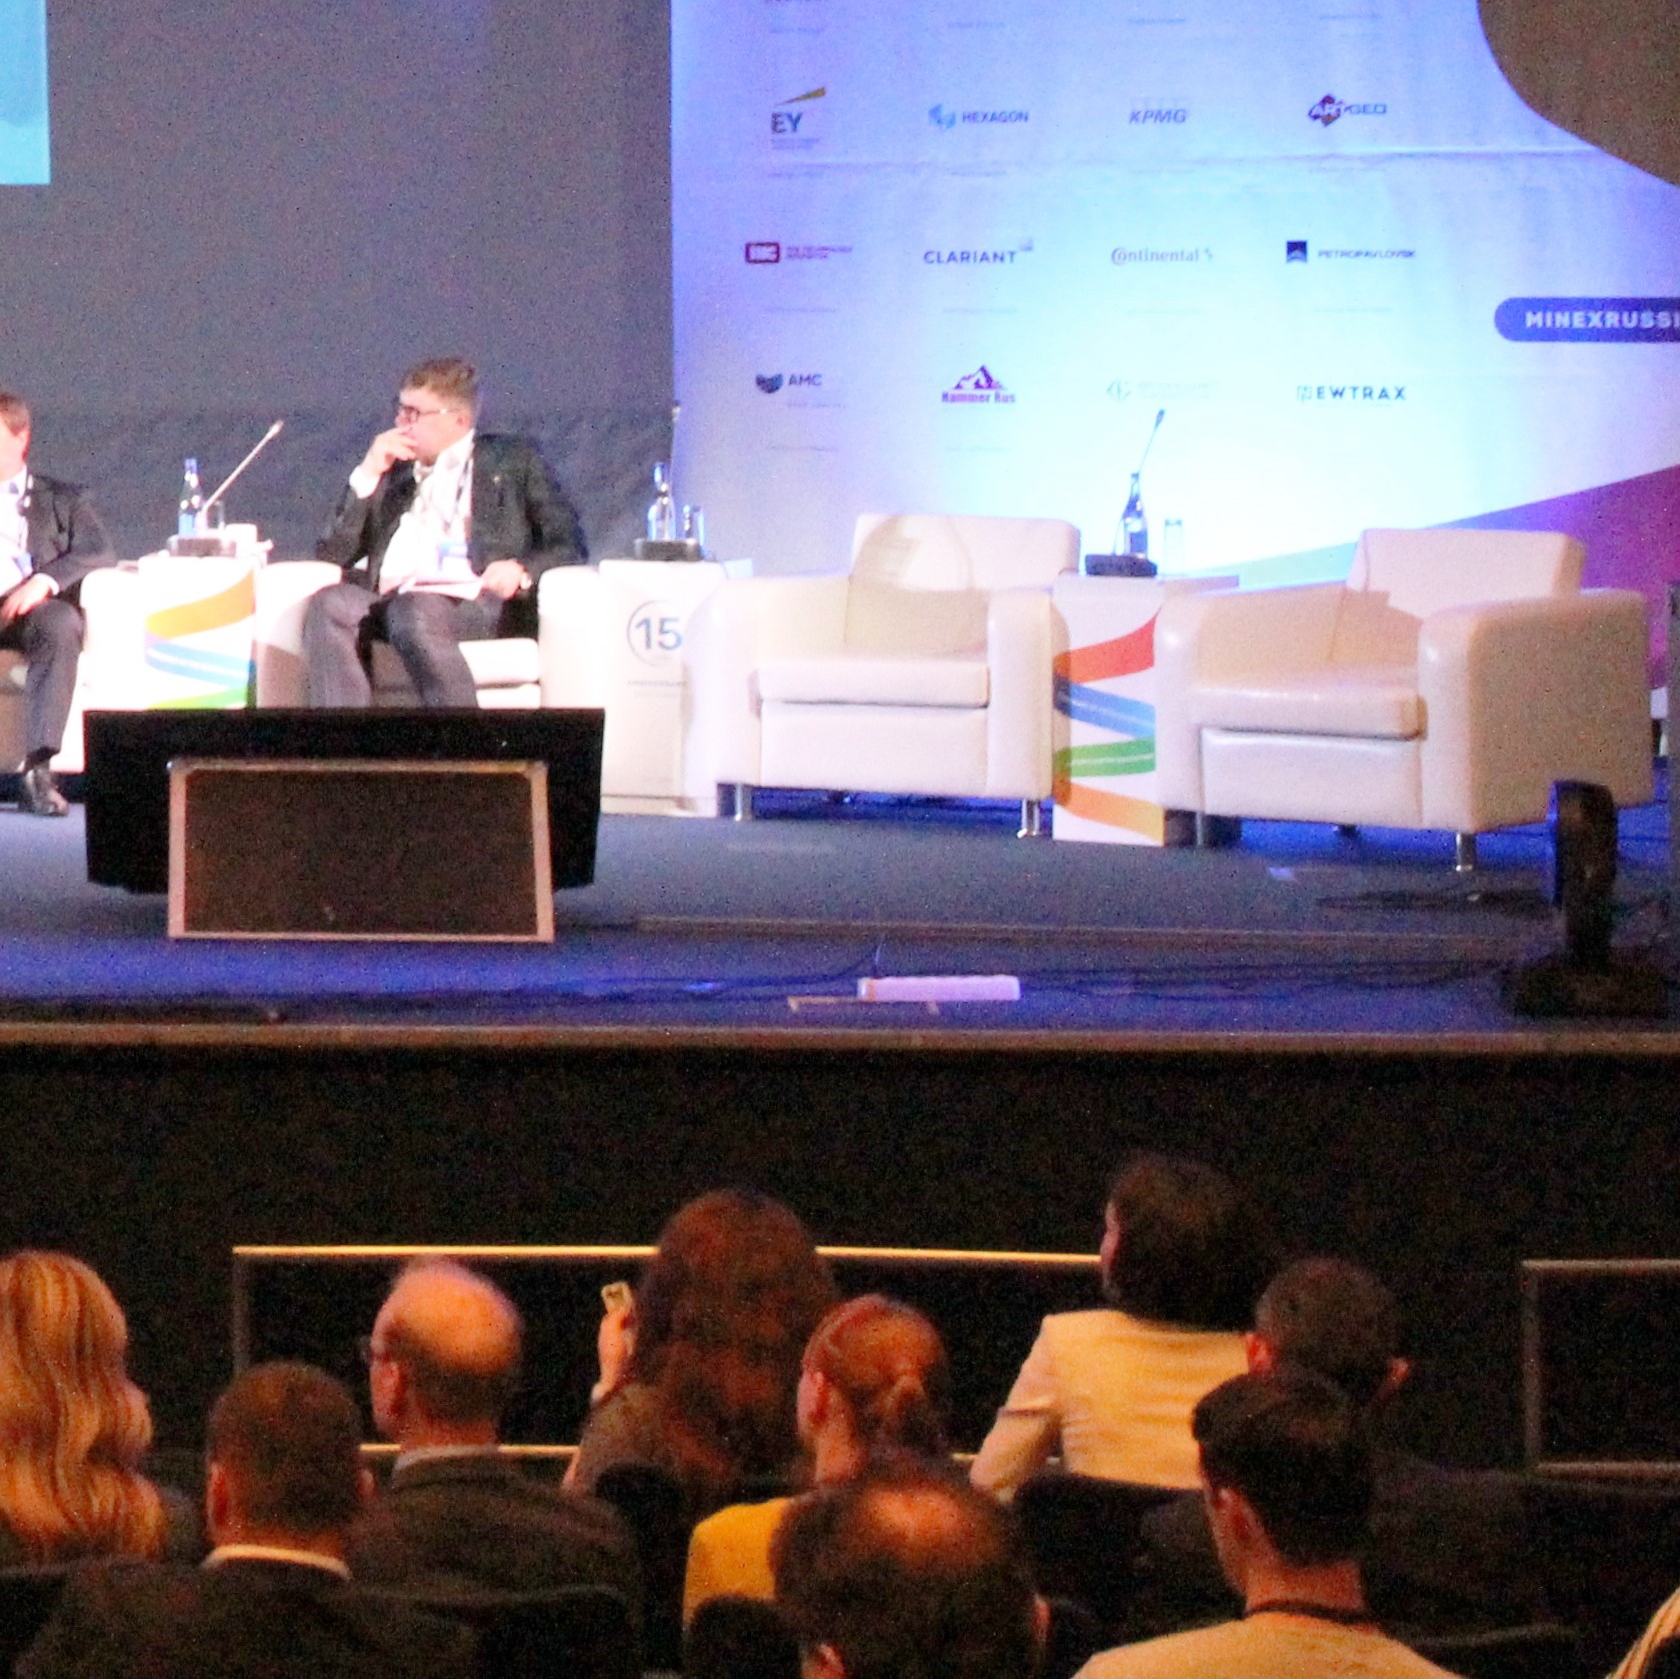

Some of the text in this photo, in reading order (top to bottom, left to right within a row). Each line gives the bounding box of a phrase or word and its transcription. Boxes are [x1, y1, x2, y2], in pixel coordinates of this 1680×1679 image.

[771, 110, 804, 134] EY
[1128, 108, 1190, 125] KPMG
[923, 249, 1018, 265] CLARIANT
[635, 616, 684, 651] 15
